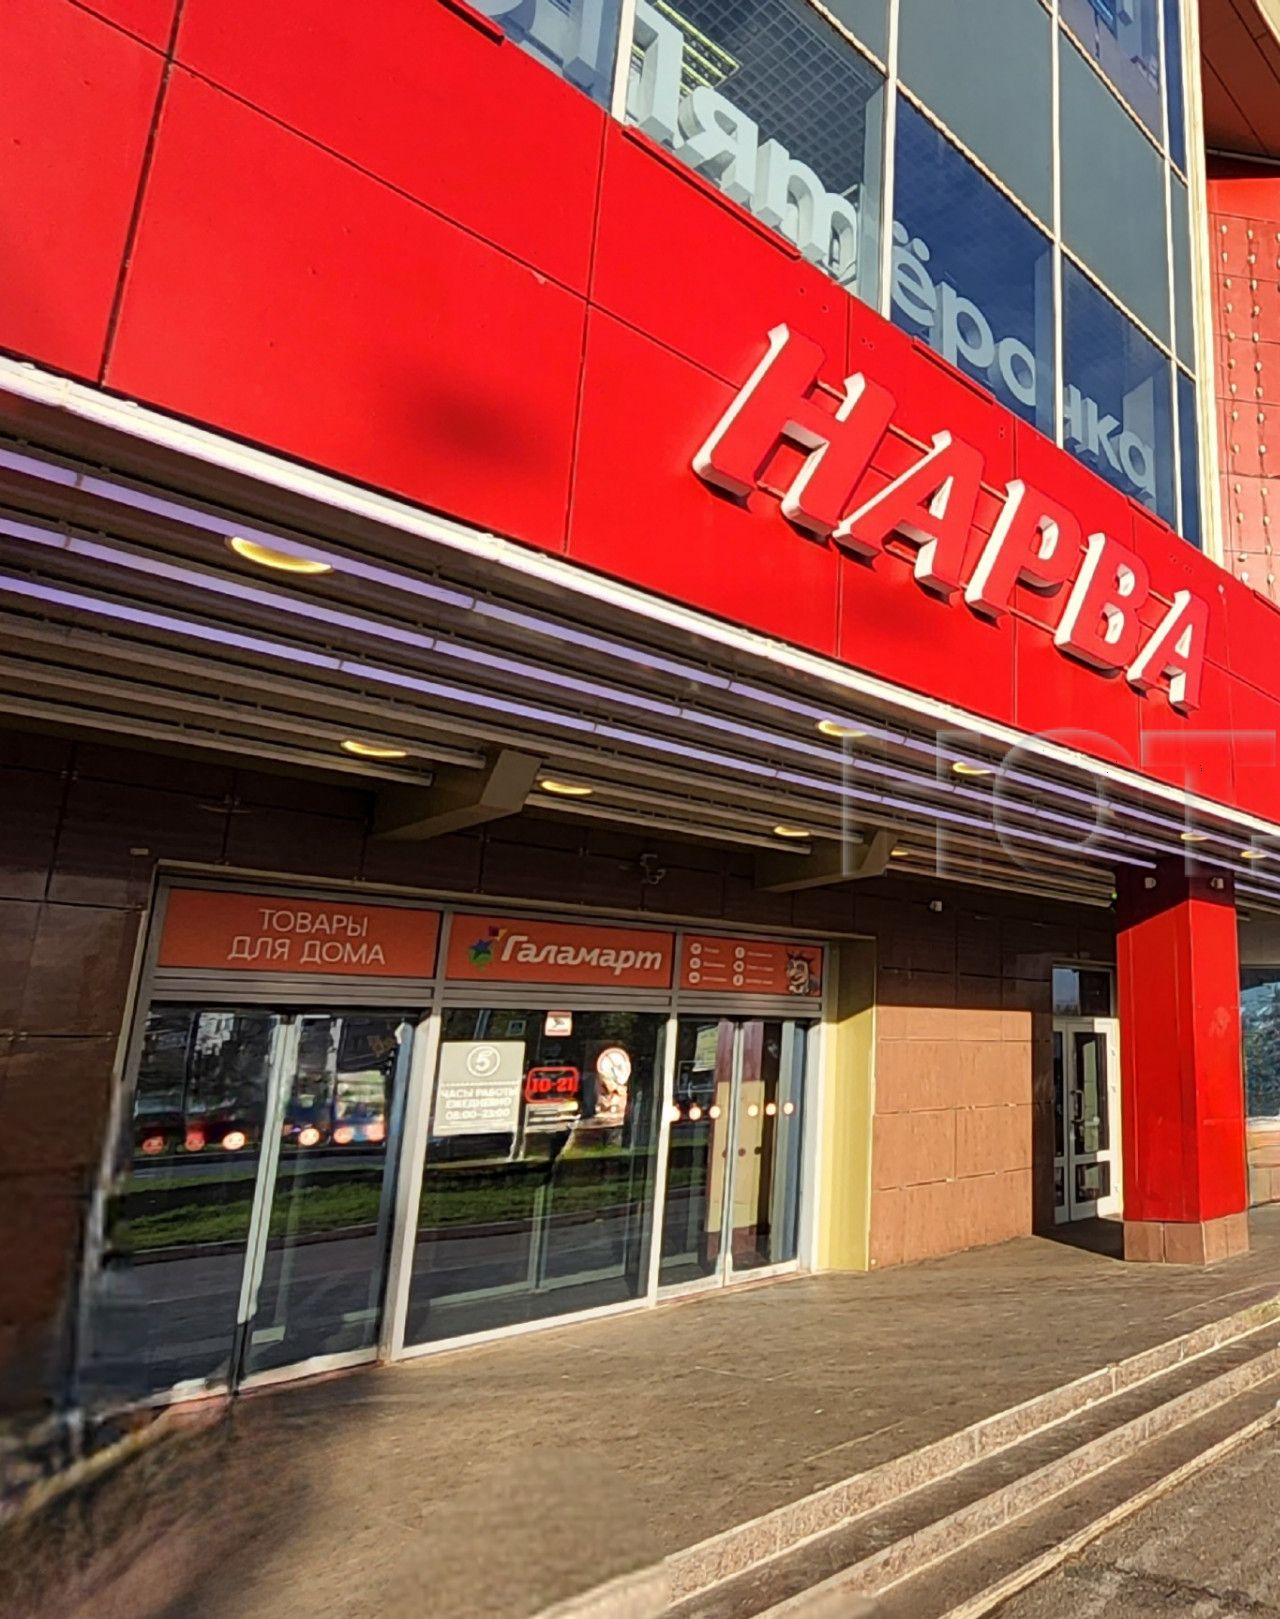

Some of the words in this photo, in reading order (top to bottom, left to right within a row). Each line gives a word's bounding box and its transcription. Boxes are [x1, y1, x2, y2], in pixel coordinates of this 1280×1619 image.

[692, 322, 1210, 712] НАРВА
[259, 908, 368, 938] ТОВАРЫ
[227, 936, 289, 962] ДЛЯ
[300, 941, 386, 966] ДОМА
[501, 935, 663, 976] Галамарт
[441, 1087, 474, 1099] ЧАСЫ
[531, 1077, 575, 1093] 10-21
